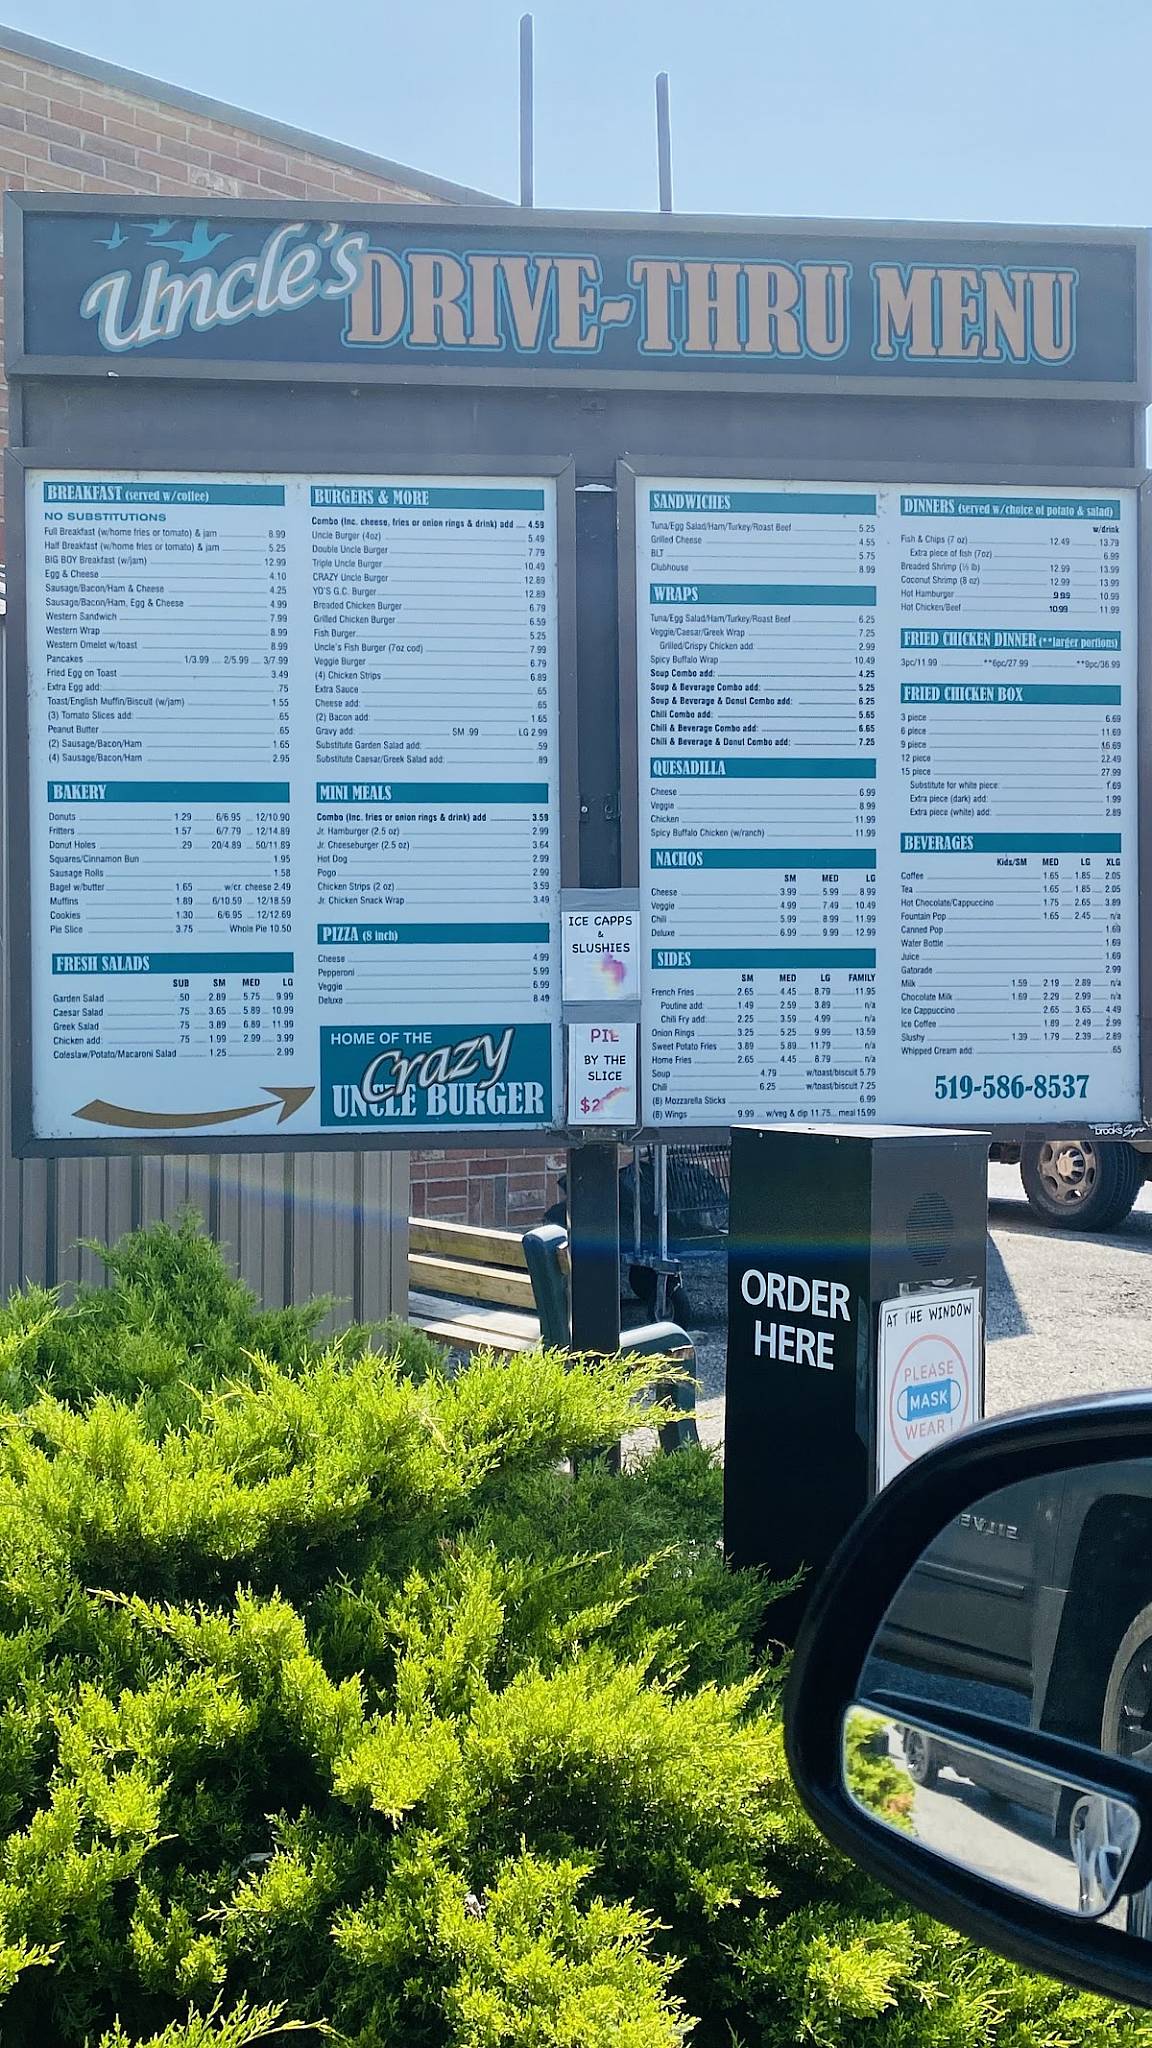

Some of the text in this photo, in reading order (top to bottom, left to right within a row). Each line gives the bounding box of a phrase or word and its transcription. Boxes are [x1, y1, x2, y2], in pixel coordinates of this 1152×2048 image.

[82, 223, 366, 350] Uncle's
[343, 250, 1078, 364] DRIVE-THRU MENU
[48, 485, 123, 500] BREAKFAST
[125, 490, 161, 502] (served
[315, 489, 429, 506] BURGERS & MORE
[654, 494, 731, 510] SANDWICHES
[905, 499, 955, 514] DINNERS
[1077, 505, 1084, 516] &
[45, 512, 166, 522] NO SUBSTITUTIONS
[312, 531, 333, 540] Uncle
[335, 531, 360, 541] Burger
[1093, 525, 1119, 534] w/drink
[651, 549, 664, 557] BLT
[45, 556, 61, 565] BIG
[62, 556, 77, 565] BOY
[79, 556, 115, 565] Breakfast
[45, 570, 60, 580] Egg
[63, 570, 68, 578] &
[70, 570, 99, 579] Cheese
[313, 574, 338, 582] CRAZY
[340, 574, 361, 582] Uncle
[364, 574, 388, 584] Burger
[933, 576, 957, 586] Shrimp
[654, 586, 699, 601] WRAPS
[46, 612, 77, 621] Western
[80, 612, 117, 621] Sandwich
[904, 632, 939, 646] FRIED
[943, 632, 991, 647] CHICKEN
[995, 633, 1036, 647] DINNER
[46, 655, 83, 664] Pancakes
[904, 687, 1023, 701] FRIED CHICKEN BOX
[653, 761, 726, 776] QUESADILLA
[53, 785, 106, 800] BAKERY
[320, 786, 392, 800] MINI MEALS
[49, 813, 75, 821] Donuts
[651, 829, 670, 838] Spicy
[672, 829, 697, 837] Buffalo
[700, 829, 728, 837] Chicken
[731, 829, 765, 838] (w/ranch)
[905, 835, 973, 850] BEVERAGES
[656, 852, 703, 866] NACHOS
[996, 858, 1121, 866] Kids/SM MED LG XLG
[901, 871, 924, 880] Coffee
[1043, 872, 1059, 880] 1.65
[651, 888, 678, 896] Cheese
[569, 915, 633, 927] ICE CAPPS
[323, 926, 359, 942] PIZZA
[598, 930, 604, 938] &
[571, 942, 630, 954] SLUSHIES
[56, 956, 150, 972] FRESH SALADS
[658, 951, 692, 966] SIDES
[172, 978, 293, 988] SUB SM MED LG
[742, 974, 754, 982] SM
[779, 974, 797, 982] MED
[848, 974, 876, 982] FAMILY
[901, 980, 916, 988] Milk
[331, 1032, 433, 1045] HOME OF THE
[652, 1029, 672, 1037] Onion
[674, 1029, 695, 1037] Rings
[737, 1028, 754, 1036] 3.25
[855, 1028, 876, 1036] 13.59
[361, 1027, 515, 1103] Crazy
[584, 1055, 626, 1065] BY THE
[588, 1071, 622, 1081] SLICE
[935, 1074, 1090, 1099] 519-586-8537
[332, 1082, 545, 1118] UNCLE BURGER
[664, 1097, 702, 1105] Mozzarella
[741, 1269, 851, 1322] ORDER
[887, 1303, 971, 1327] AT THE WINDOW
[754, 1320, 835, 1371] HERE
[904, 1360, 954, 1381] PLEASE
[910, 1390, 948, 1410] MASK
[905, 1419, 945, 1440] WEAR
